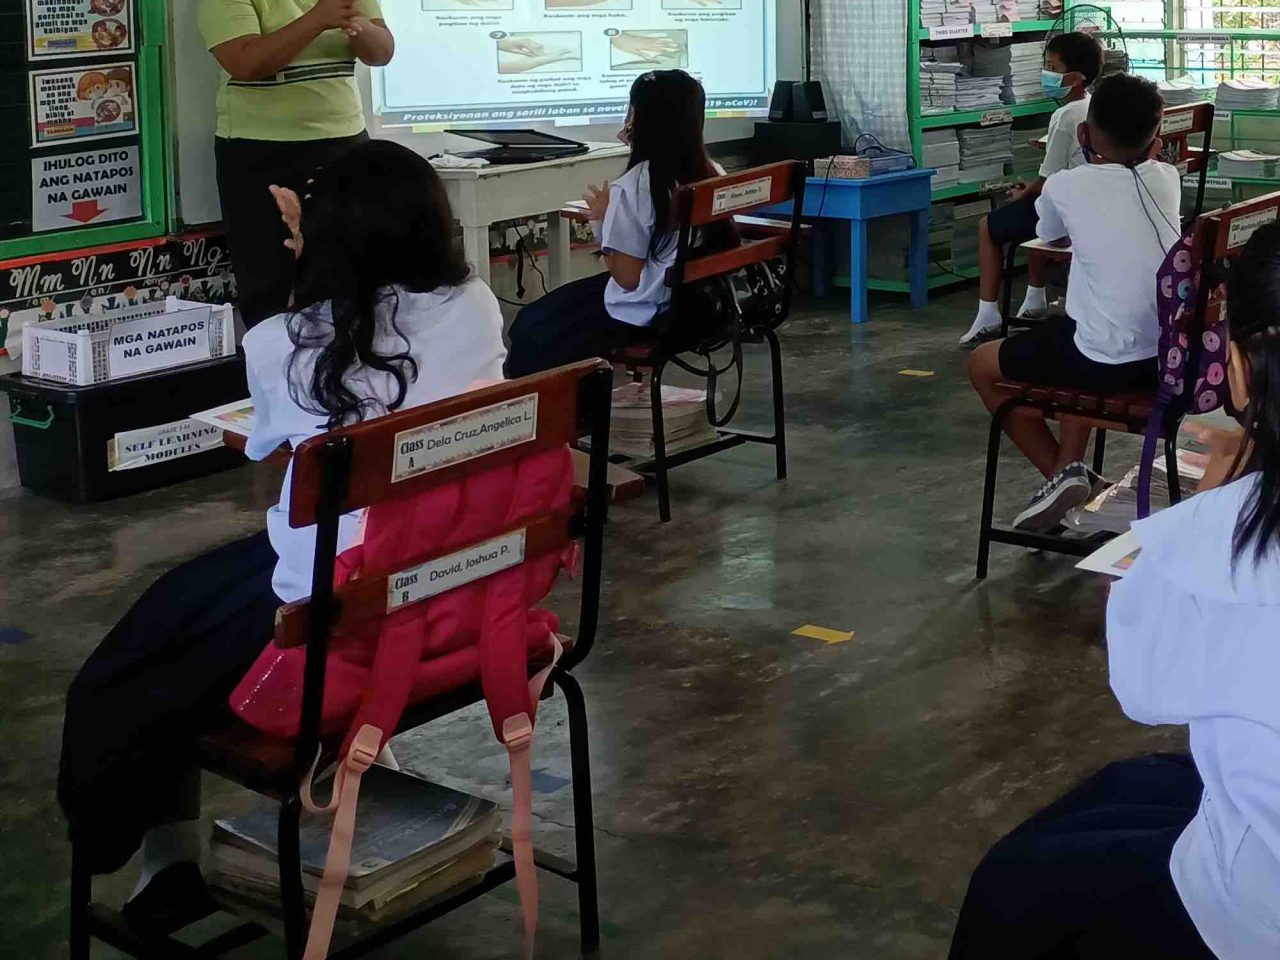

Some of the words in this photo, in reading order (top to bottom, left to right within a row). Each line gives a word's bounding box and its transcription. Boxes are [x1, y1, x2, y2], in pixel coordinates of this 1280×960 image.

[403, 110, 490, 122] Proteksiyonan
[491, 109, 515, 120] ang
[516, 107, 546, 117] sarili
[548, 105, 581, 116] laban
[43, 155, 95, 172] IHULOG
[98, 150, 129, 166] DITO
[39, 174, 70, 189] ANG
[73, 166, 134, 183] NATAPOS
[47, 191, 68, 204] NA
[71, 183, 127, 200] GAWAIN
[113, 333, 144, 347] MGA
[147, 320, 205, 340] NATAPOS
[123, 347, 142, 359] NA
[145, 336, 197, 355] GAWAIN
[125, 439, 157, 453] SELF
[159, 426, 218, 447] LEARNING
[400, 439, 424, 455] Class
[426, 436, 451, 451] Dela
[480, 414, 521, 434] Angelica
[144, 443, 201, 462] MODULES
[408, 456, 415, 469] A
[395, 573, 419, 590] Class
[465, 552, 498, 570] Joshua
[402, 591, 409, 603] B
